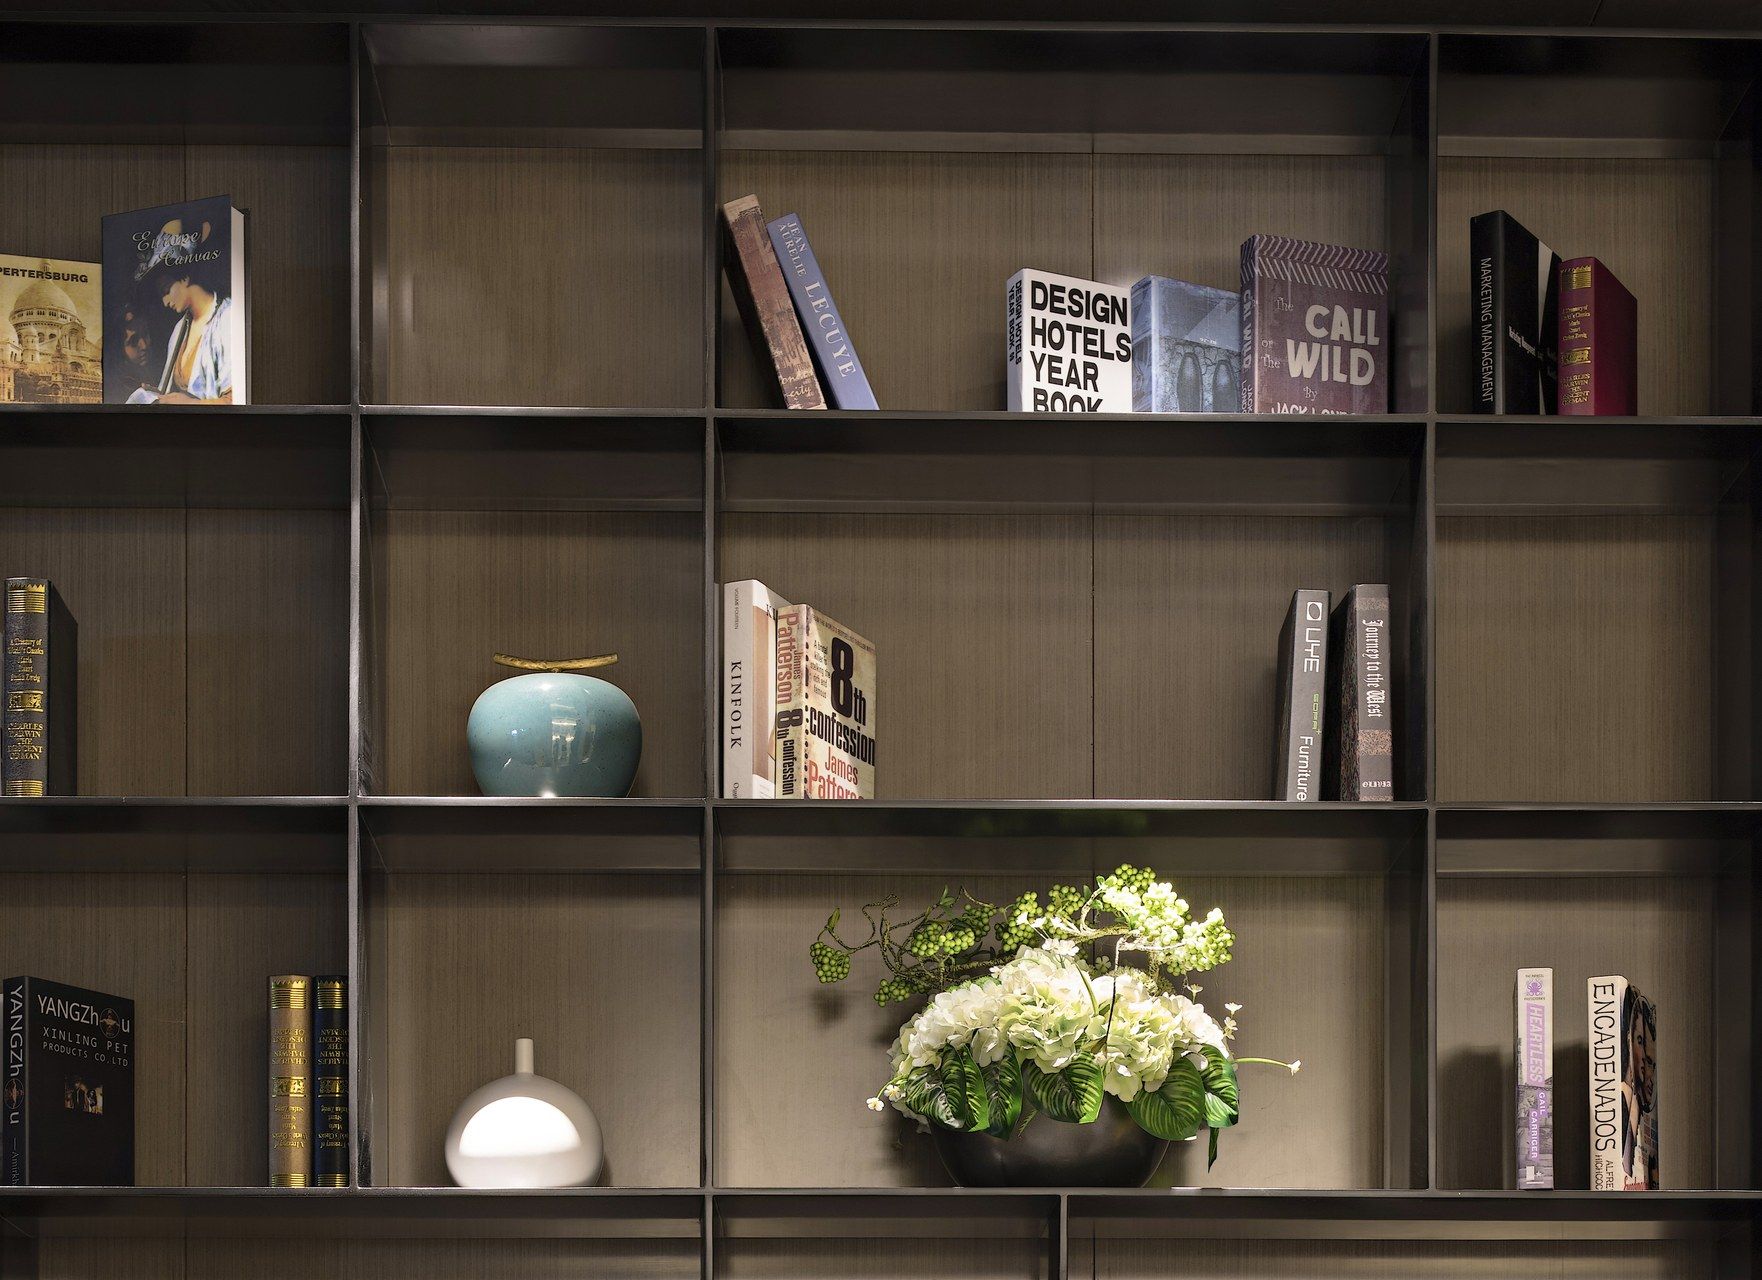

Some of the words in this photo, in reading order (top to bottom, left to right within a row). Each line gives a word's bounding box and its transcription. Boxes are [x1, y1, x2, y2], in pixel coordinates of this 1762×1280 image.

[159, 248, 221, 267] Canvas
[787, 222, 808, 253] JEAN
[777, 223, 807, 277] AURELIE
[804, 281, 857, 378] LECUYE
[1030, 280, 1128, 327] DESIGN
[1480, 257, 1493, 322] MARKETING
[1030, 316, 1132, 363] HOTELS
[1274, 297, 1294, 312] The
[1305, 304, 1380, 346] CALL
[1030, 350, 1099, 393] YEAR
[1261, 353, 1281, 369] The
[1287, 338, 1375, 386] WILD
[1481, 324, 1493, 402] MANAGEMENT
[1033, 387, 1103, 412] BOOK
[1303, 386, 1318, 401] By
[777, 612, 799, 704] Patterson
[1362, 619, 1384, 661] Journey
[793, 650, 803, 680] James
[831, 636, 867, 727] 8th
[1367, 662, 1384, 674] to
[1367, 675, 1384, 691] the
[730, 660, 742, 749] KINFOLK
[777, 708, 804, 740] 8th
[809, 706, 876, 767] confession
[783, 739, 796, 796] confession
[809, 759, 864, 800] Patter
[824, 745, 858, 786] James
[1296, 736, 1313, 801] Furniture
[42, 1027, 97, 1048] XINLING
[106, 1042, 128, 1054] PET
[42, 1042, 88, 1059] PRODUCTS
[1528, 1005, 1543, 1083] HEARTLESS
[1593, 982, 1616, 1152] ENCADENADOS
[1538, 1092, 1546, 1115] GAIL
[1530, 1111, 1538, 1159] CARRIGER
